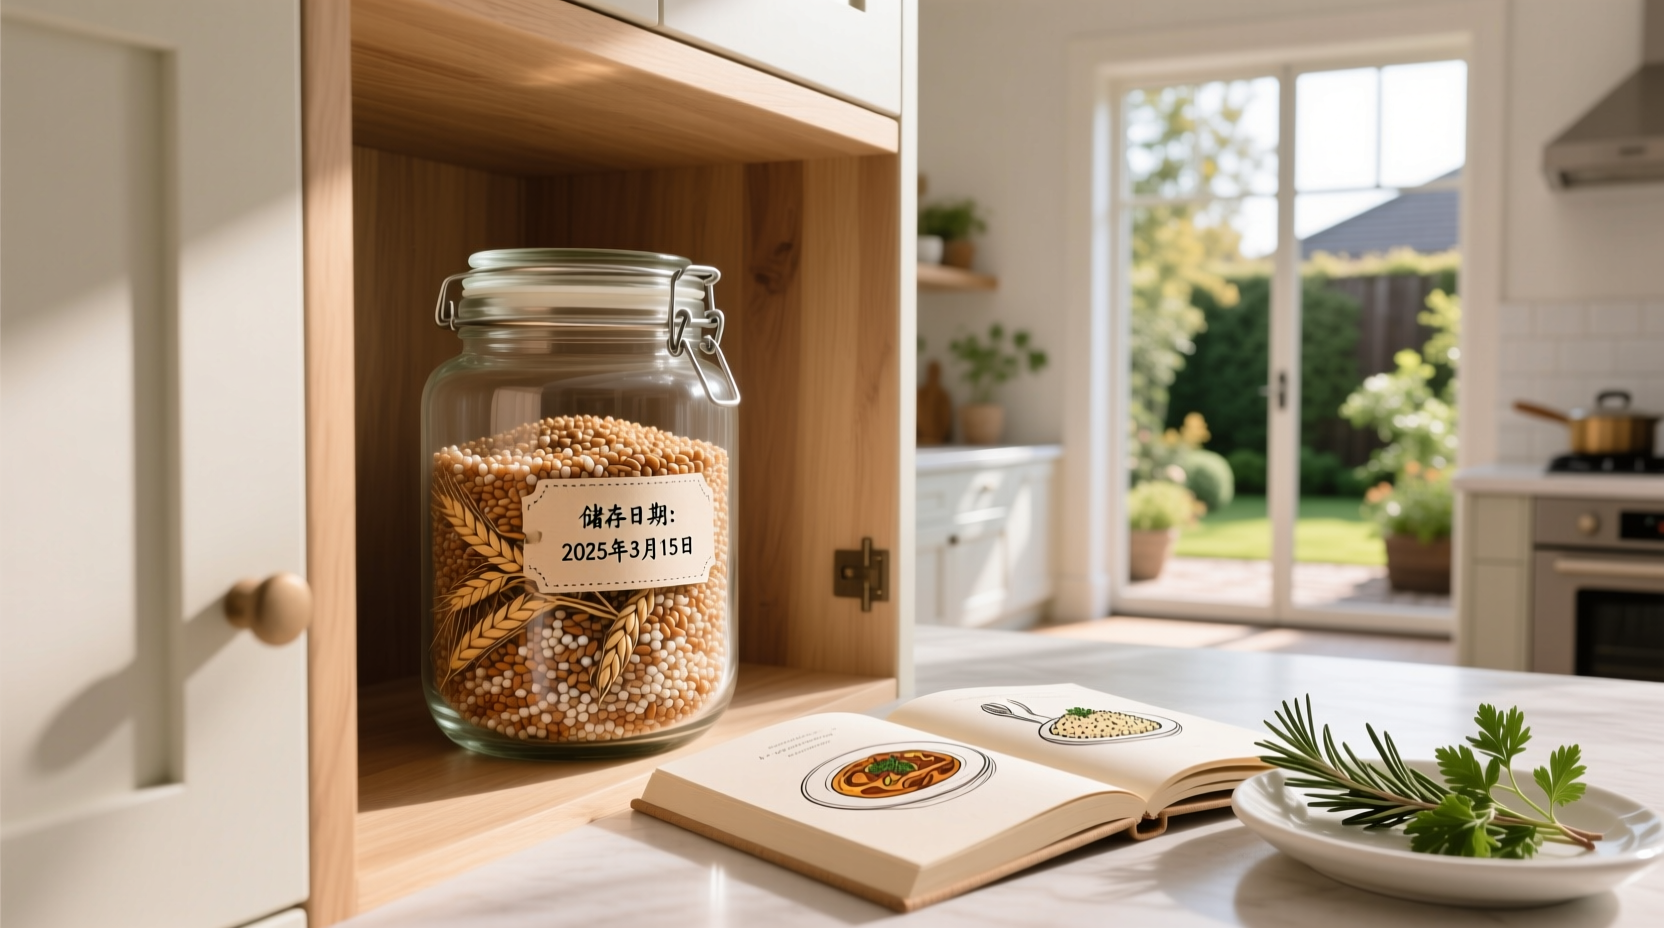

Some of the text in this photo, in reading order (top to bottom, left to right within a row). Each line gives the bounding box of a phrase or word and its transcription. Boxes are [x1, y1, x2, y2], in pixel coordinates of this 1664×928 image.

[578, 502, 675, 529] 储存日期:
[562, 536, 693, 563] 2025年3月15日
